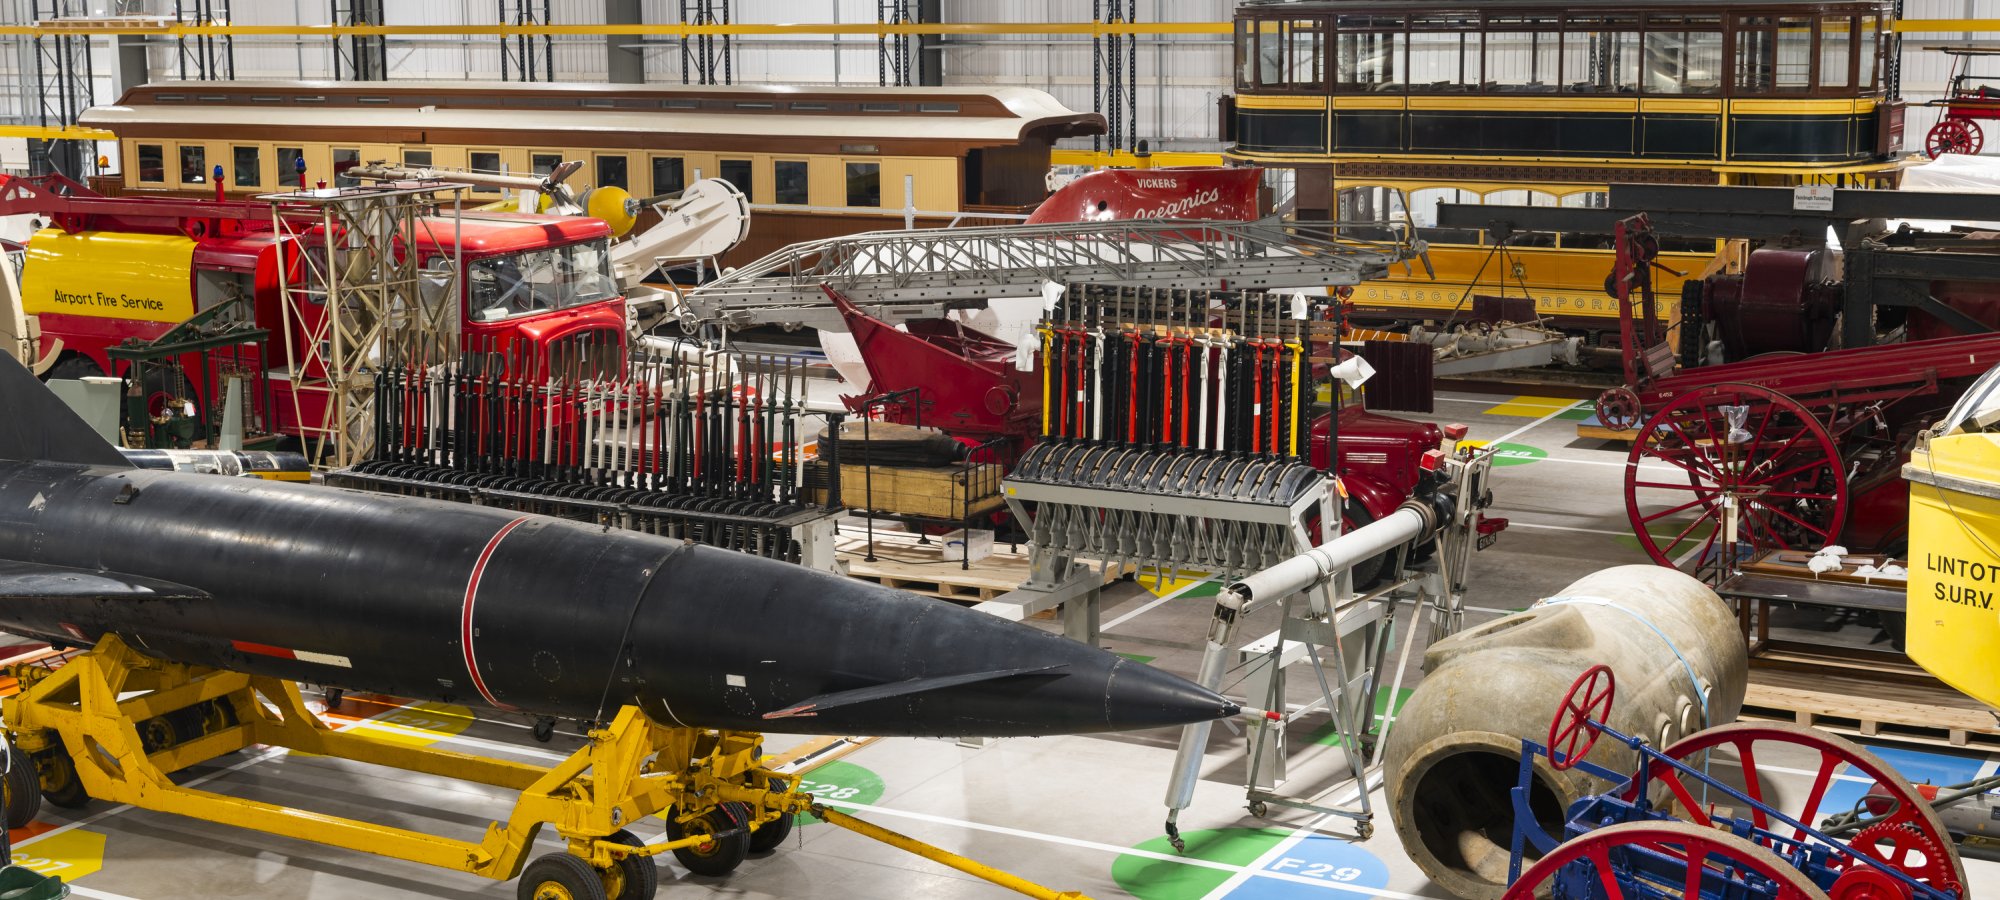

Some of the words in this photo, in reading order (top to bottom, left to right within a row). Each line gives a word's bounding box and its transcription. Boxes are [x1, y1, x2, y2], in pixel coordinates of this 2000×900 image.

[1137, 179, 1177, 189] VICKERS
[1133, 187, 1219, 220] Oceanics
[54, 289, 94, 306] Airport
[96, 292, 117, 307] Fire
[120, 294, 164, 311] Service
[1927, 552, 2000, 584] LINTOT
[1934, 581, 1994, 611] S.U.R.V.
[1270, 857, 1362, 881] F29
